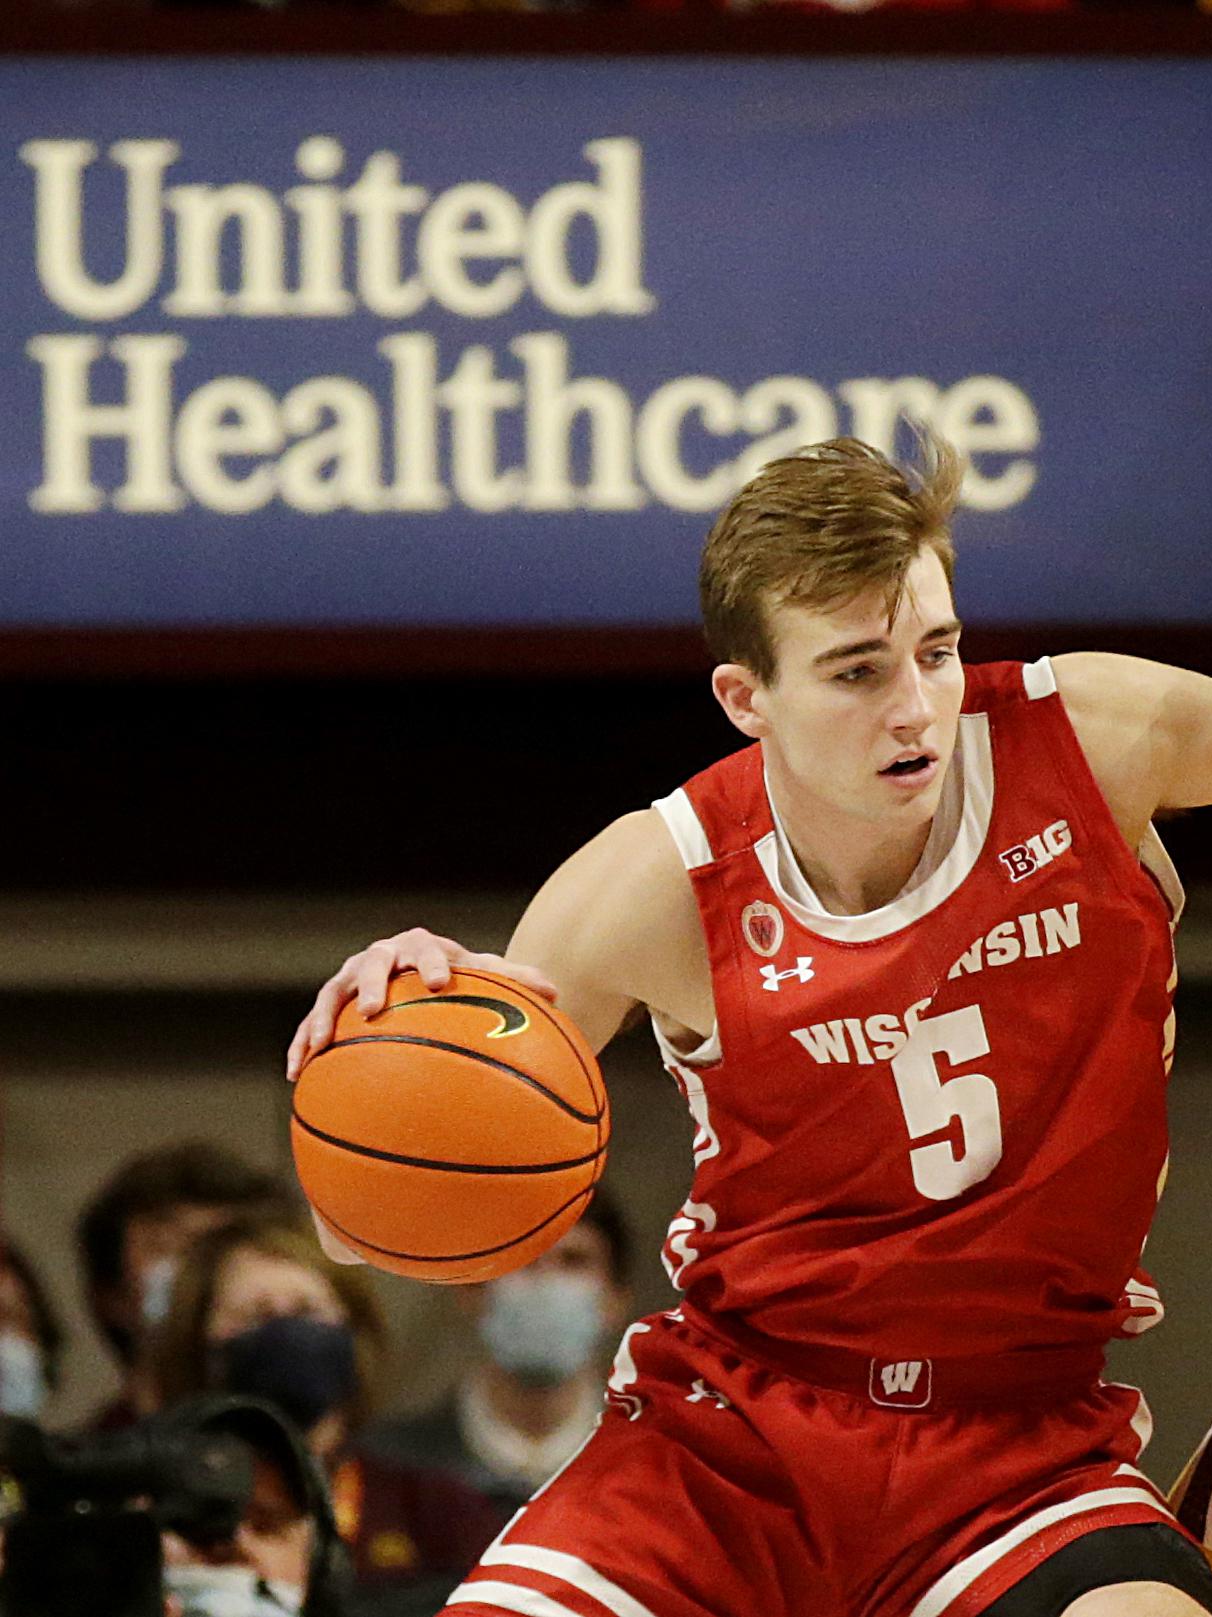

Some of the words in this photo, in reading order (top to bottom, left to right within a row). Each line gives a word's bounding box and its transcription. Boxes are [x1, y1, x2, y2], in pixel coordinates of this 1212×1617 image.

[20, 136, 655, 321] United
[27, 332, 1040, 515] Healthcare
[891, 1004, 1003, 1200] 5
[881, 1361, 922, 1395] W
